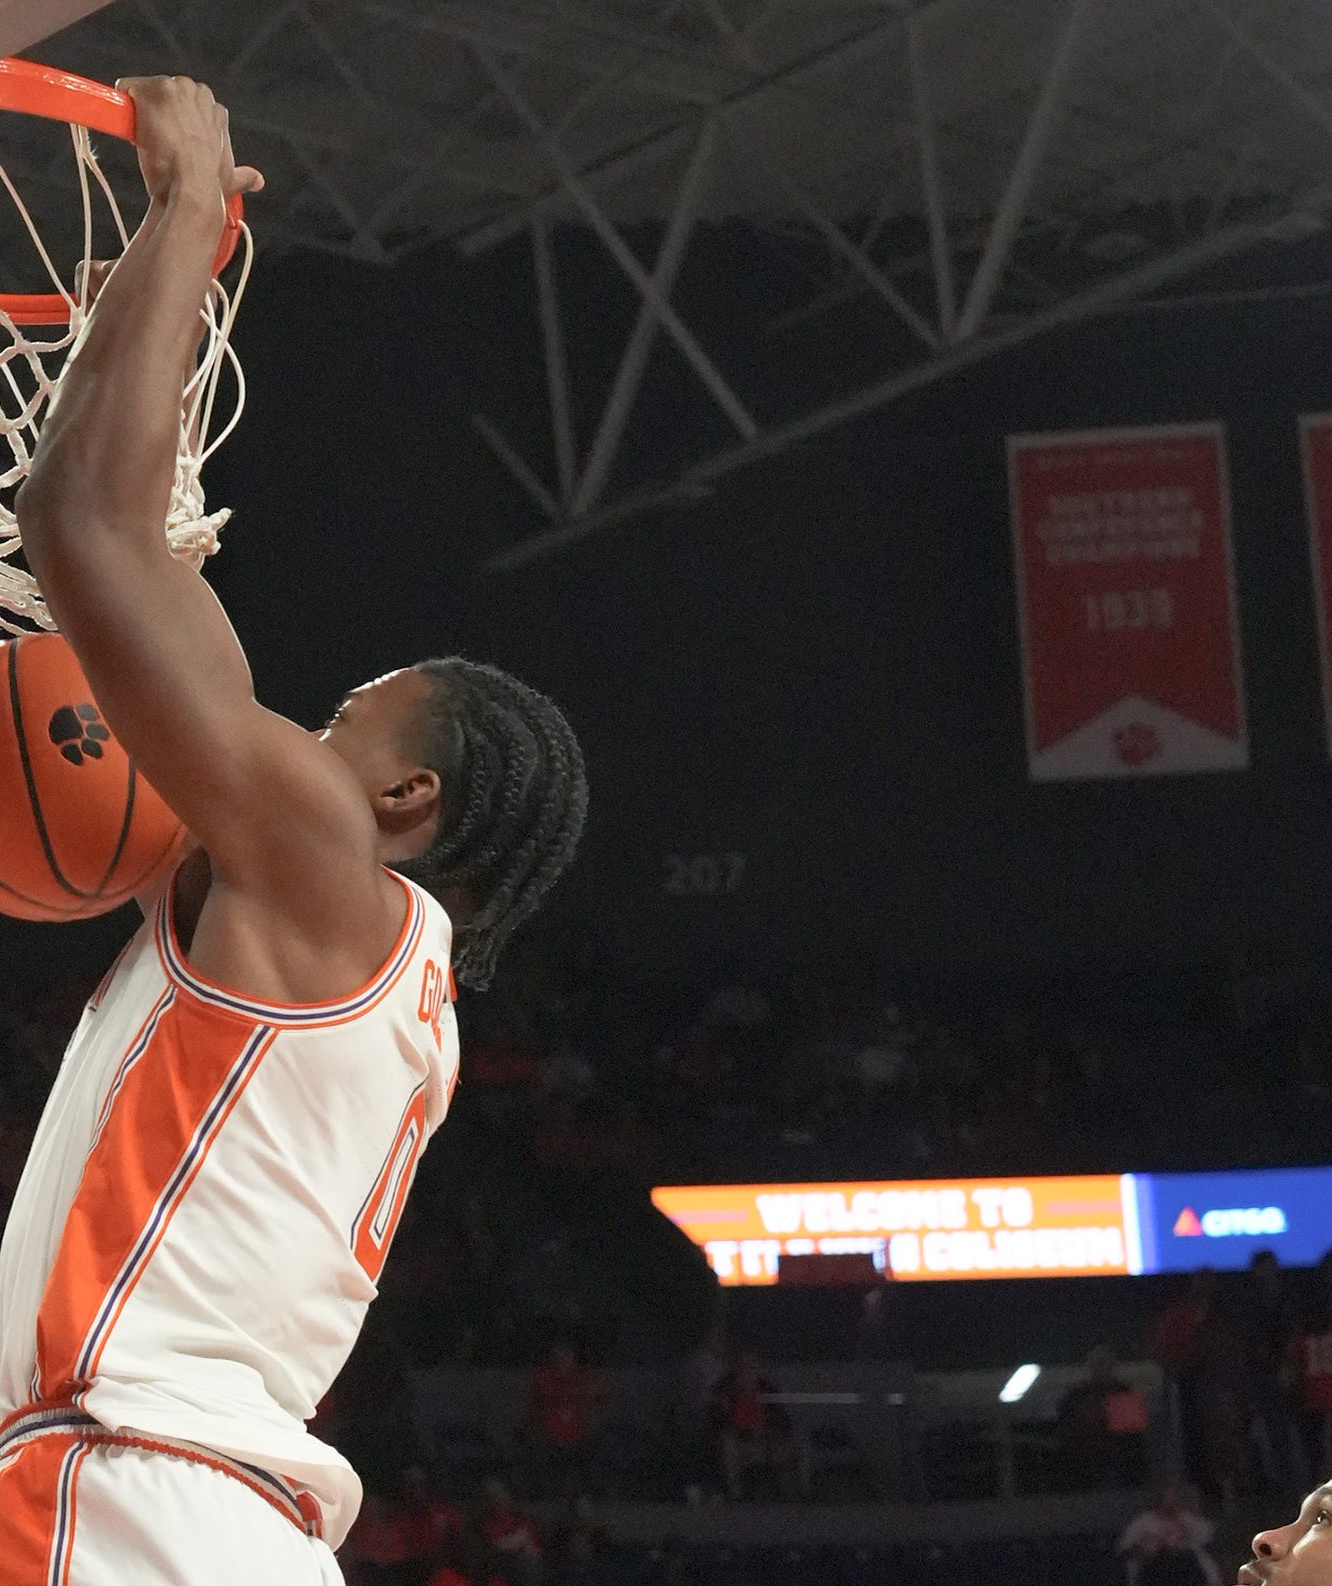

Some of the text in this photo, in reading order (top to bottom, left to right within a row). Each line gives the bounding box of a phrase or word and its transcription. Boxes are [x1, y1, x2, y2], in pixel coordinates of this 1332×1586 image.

[662, 852, 746, 895] 207
[755, 1186, 1034, 1233] WELCOME TO
[922, 1226, 1126, 1272] COLISEUM
